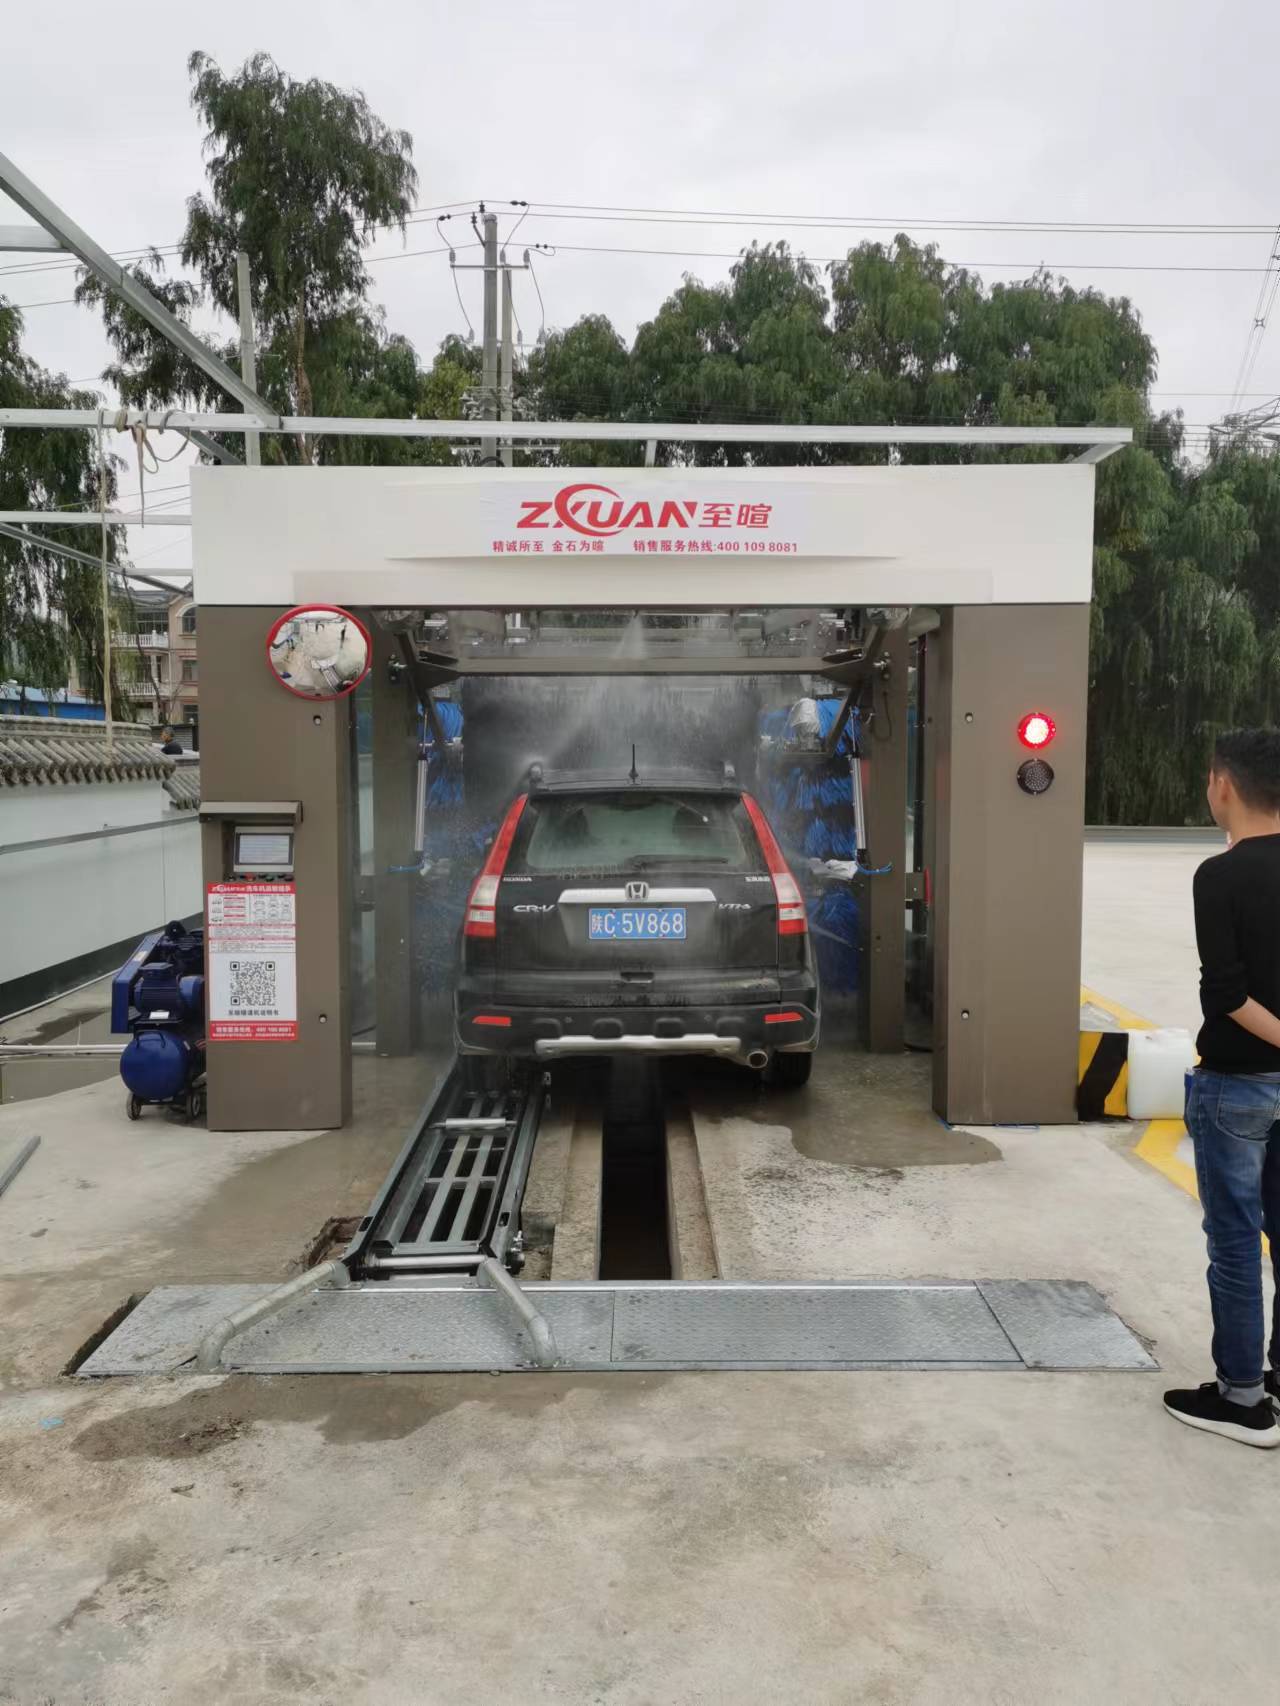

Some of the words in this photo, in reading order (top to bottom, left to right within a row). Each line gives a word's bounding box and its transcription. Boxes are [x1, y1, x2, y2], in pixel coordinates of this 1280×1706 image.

[492, 540, 544, 553] 精诚所至
[744, 541, 766, 553] 109
[769, 541, 798, 553] 8081
